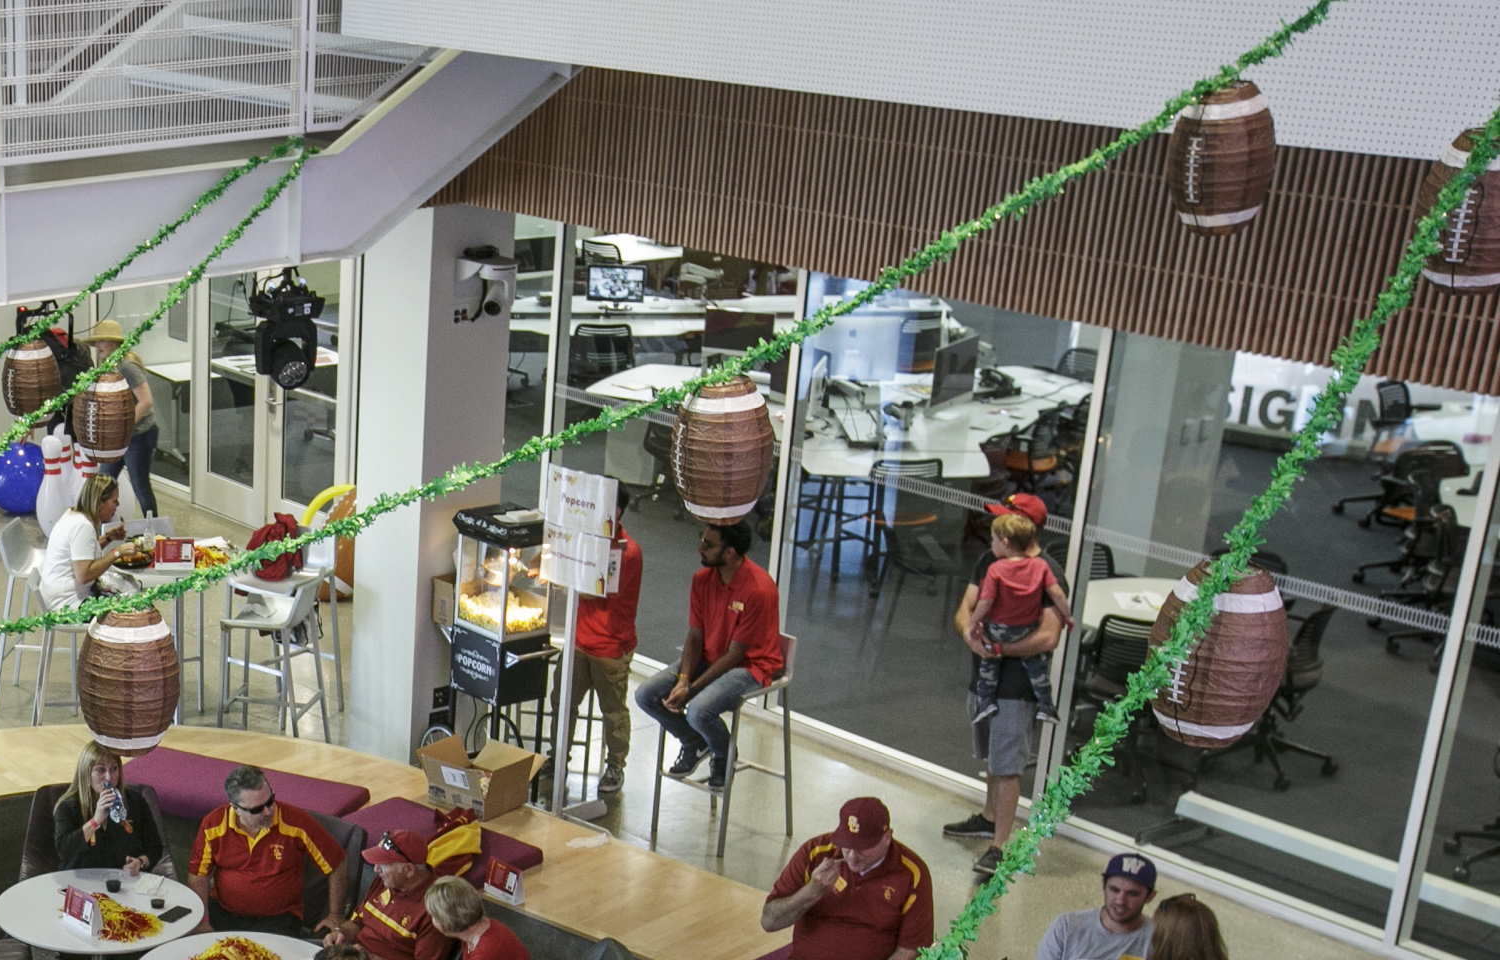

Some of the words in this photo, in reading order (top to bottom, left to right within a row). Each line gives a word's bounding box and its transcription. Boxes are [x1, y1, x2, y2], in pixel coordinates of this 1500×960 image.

[561, 492, 596, 510] Popcorn
[457, 653, 492, 676] POPCORN
[1121, 856, 1146, 875] W
